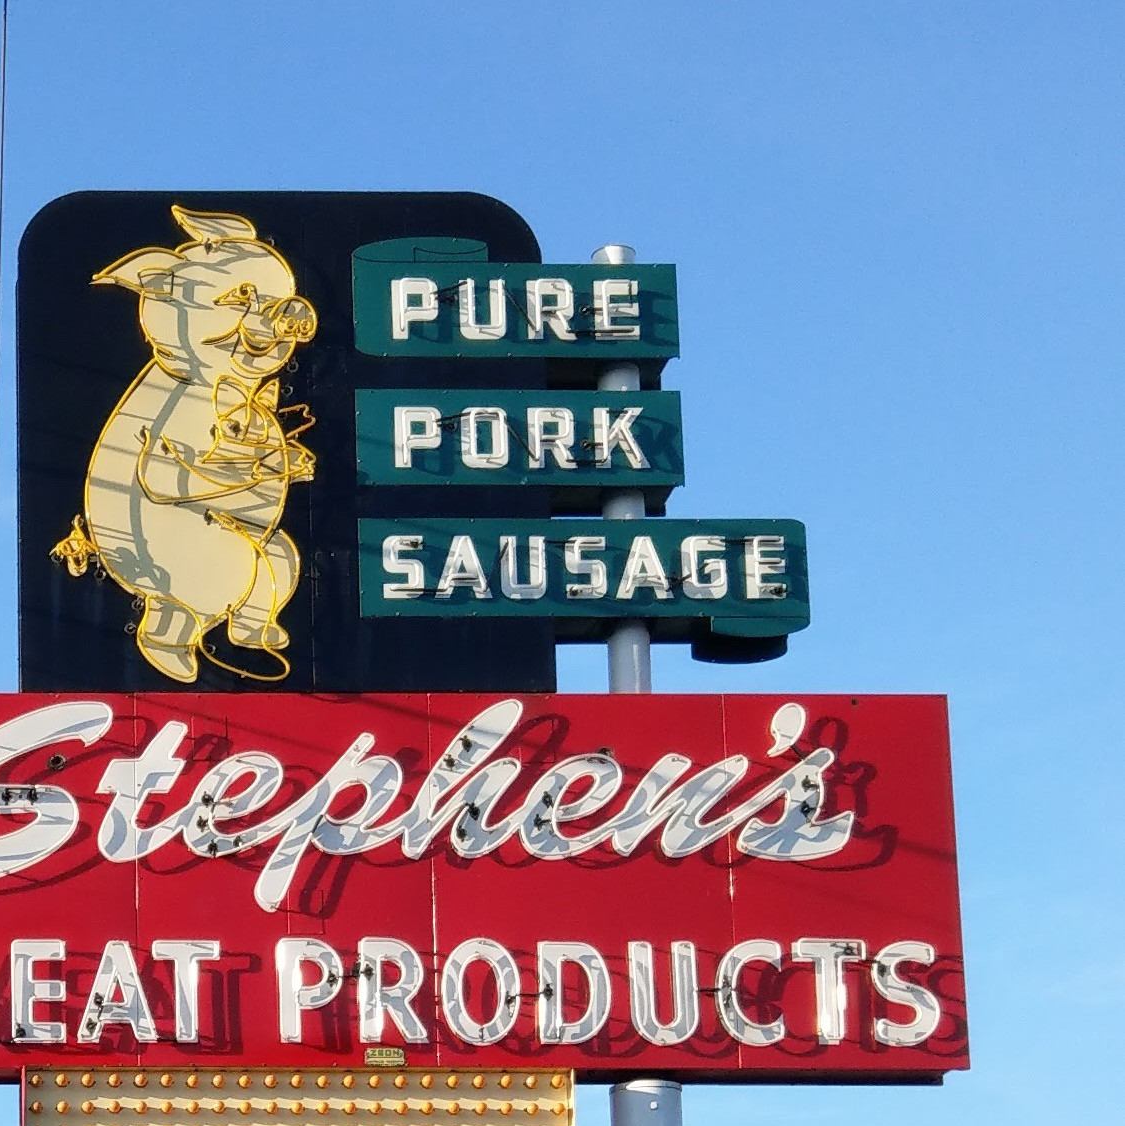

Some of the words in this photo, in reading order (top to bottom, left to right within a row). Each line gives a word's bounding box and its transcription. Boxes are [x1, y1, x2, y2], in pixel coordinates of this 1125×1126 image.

[390, 277, 641, 341] PURE
[393, 406, 652, 469] PORK
[382, 534, 787, 600] SAUSAGE
[276, 936, 939, 1047] PRODUCTS
